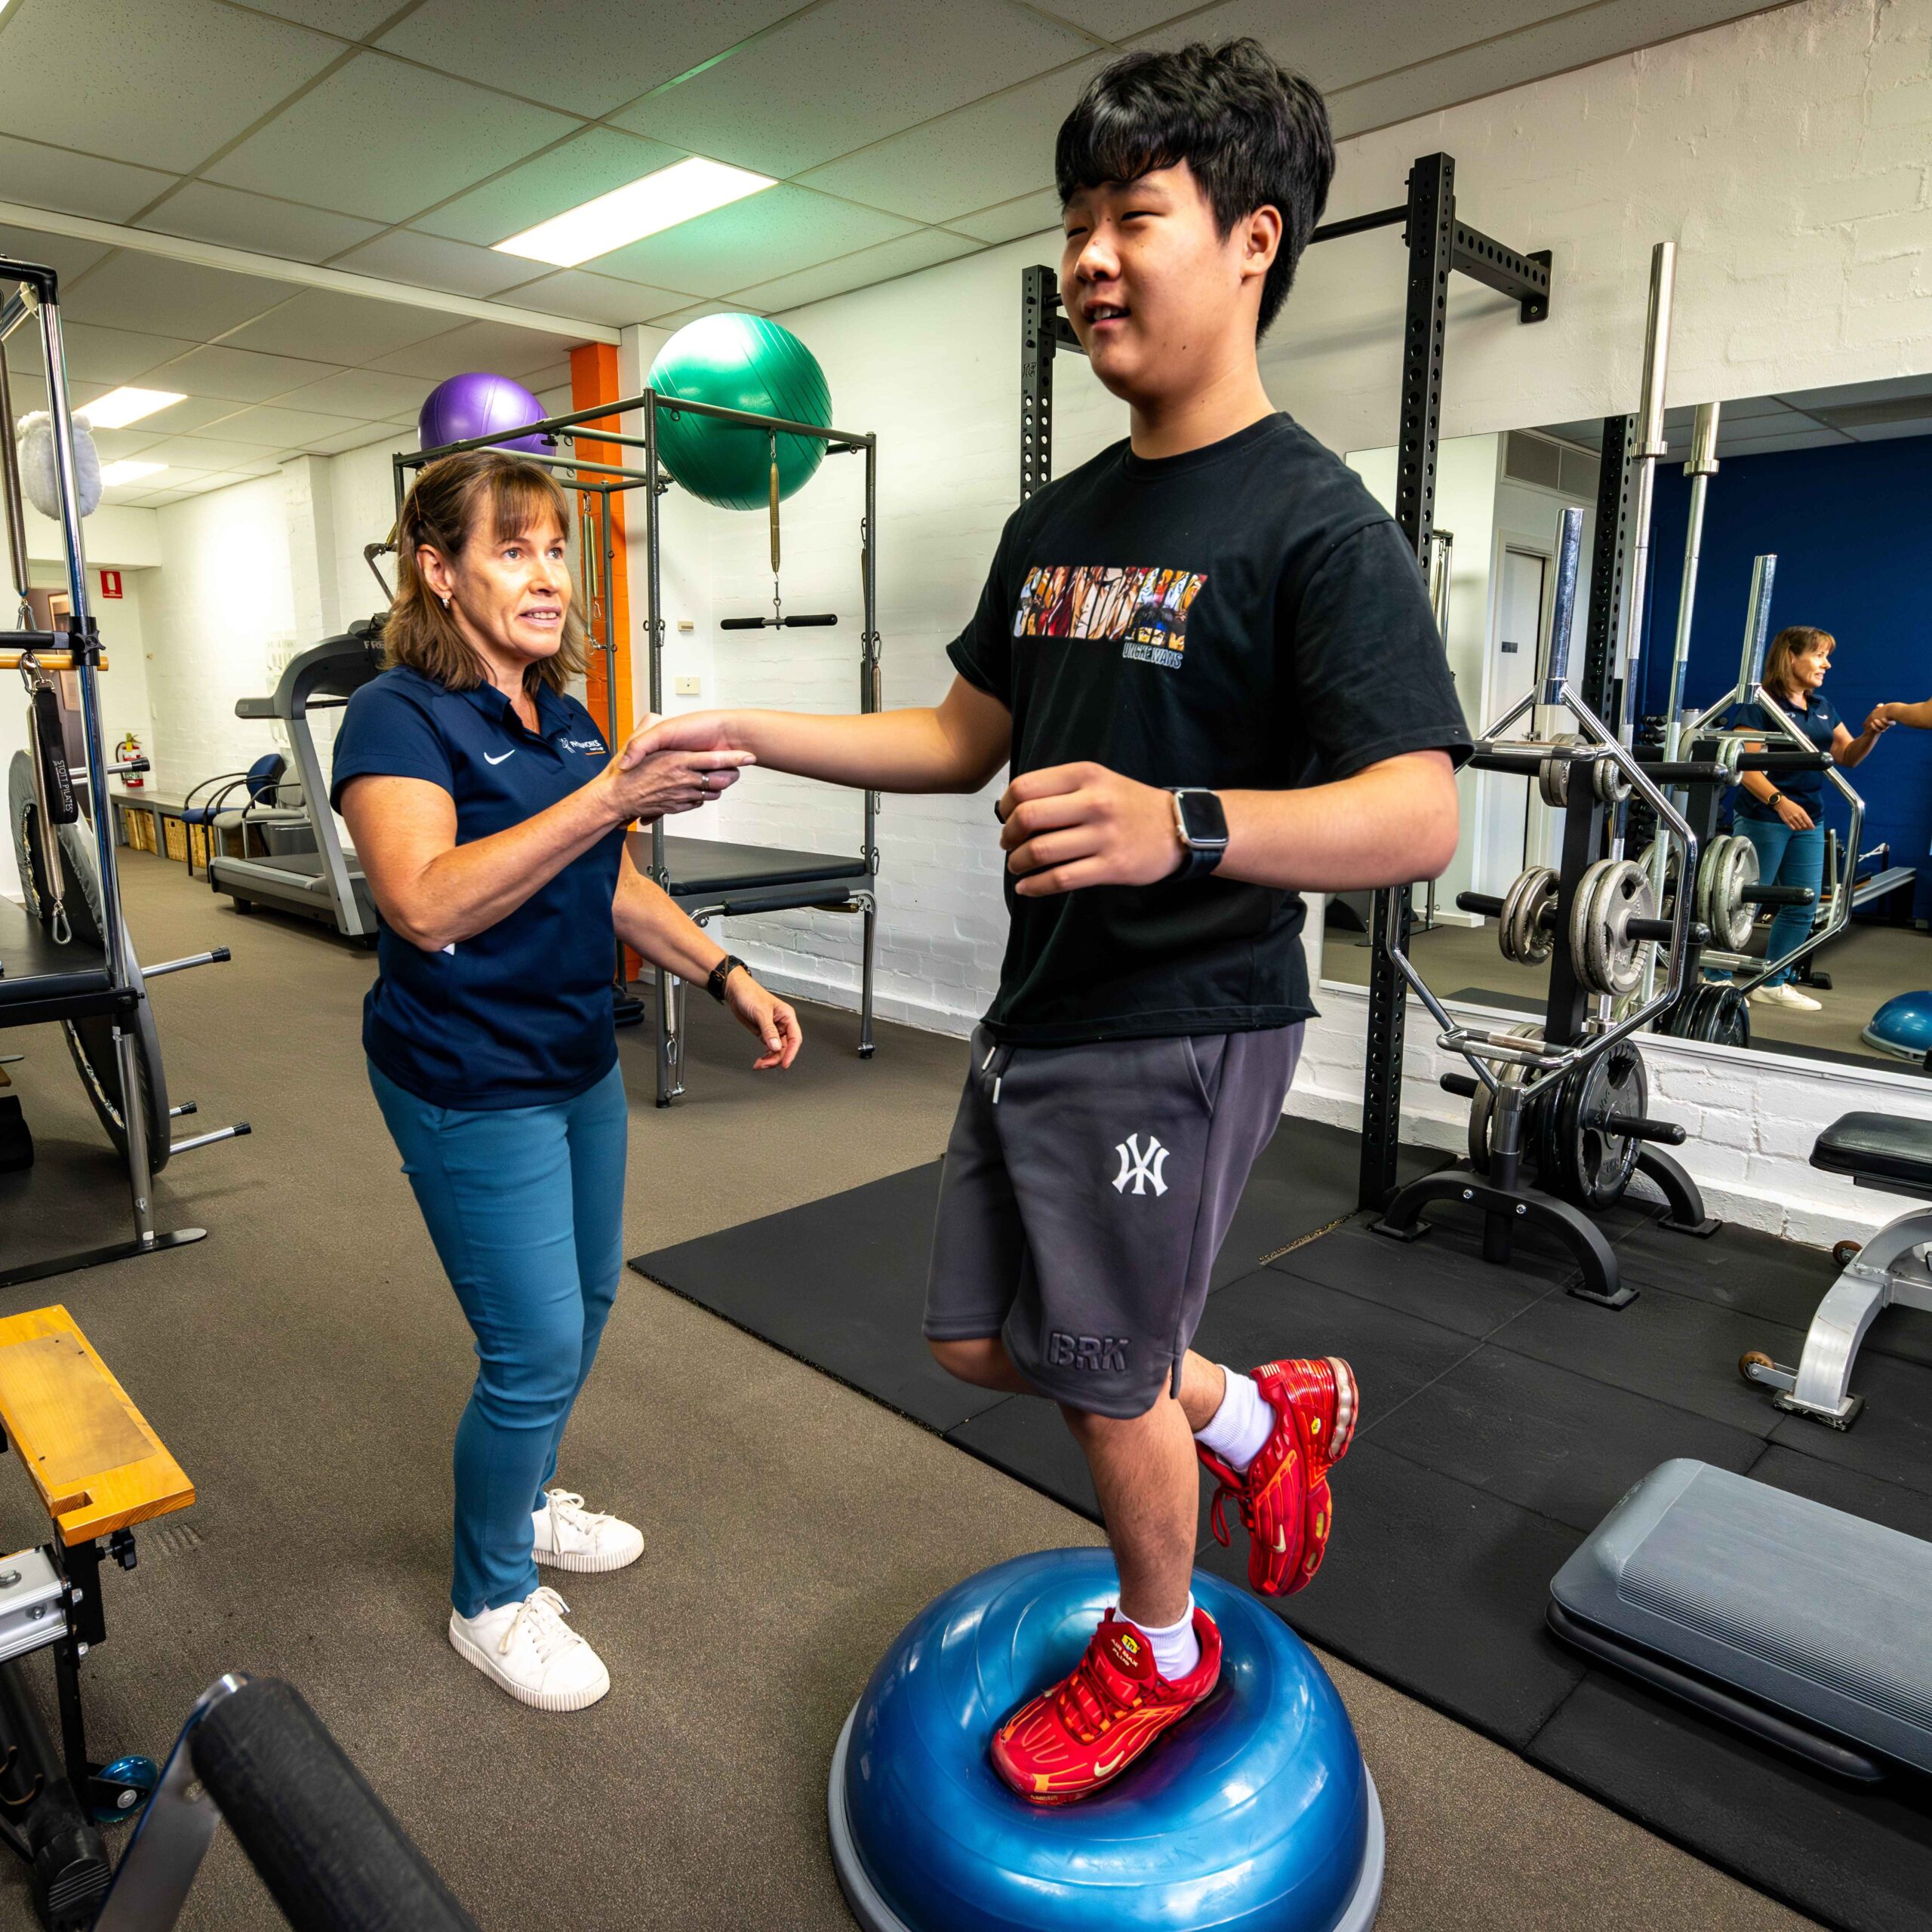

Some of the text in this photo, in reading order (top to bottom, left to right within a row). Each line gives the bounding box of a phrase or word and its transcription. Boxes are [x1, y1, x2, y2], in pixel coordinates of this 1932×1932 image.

[57, 760, 69, 782] STOTT
[62, 784, 73, 812] PILATES
[1048, 1332, 1129, 1372] BRK
[1111, 1638, 1138, 1668] AIR MAX
